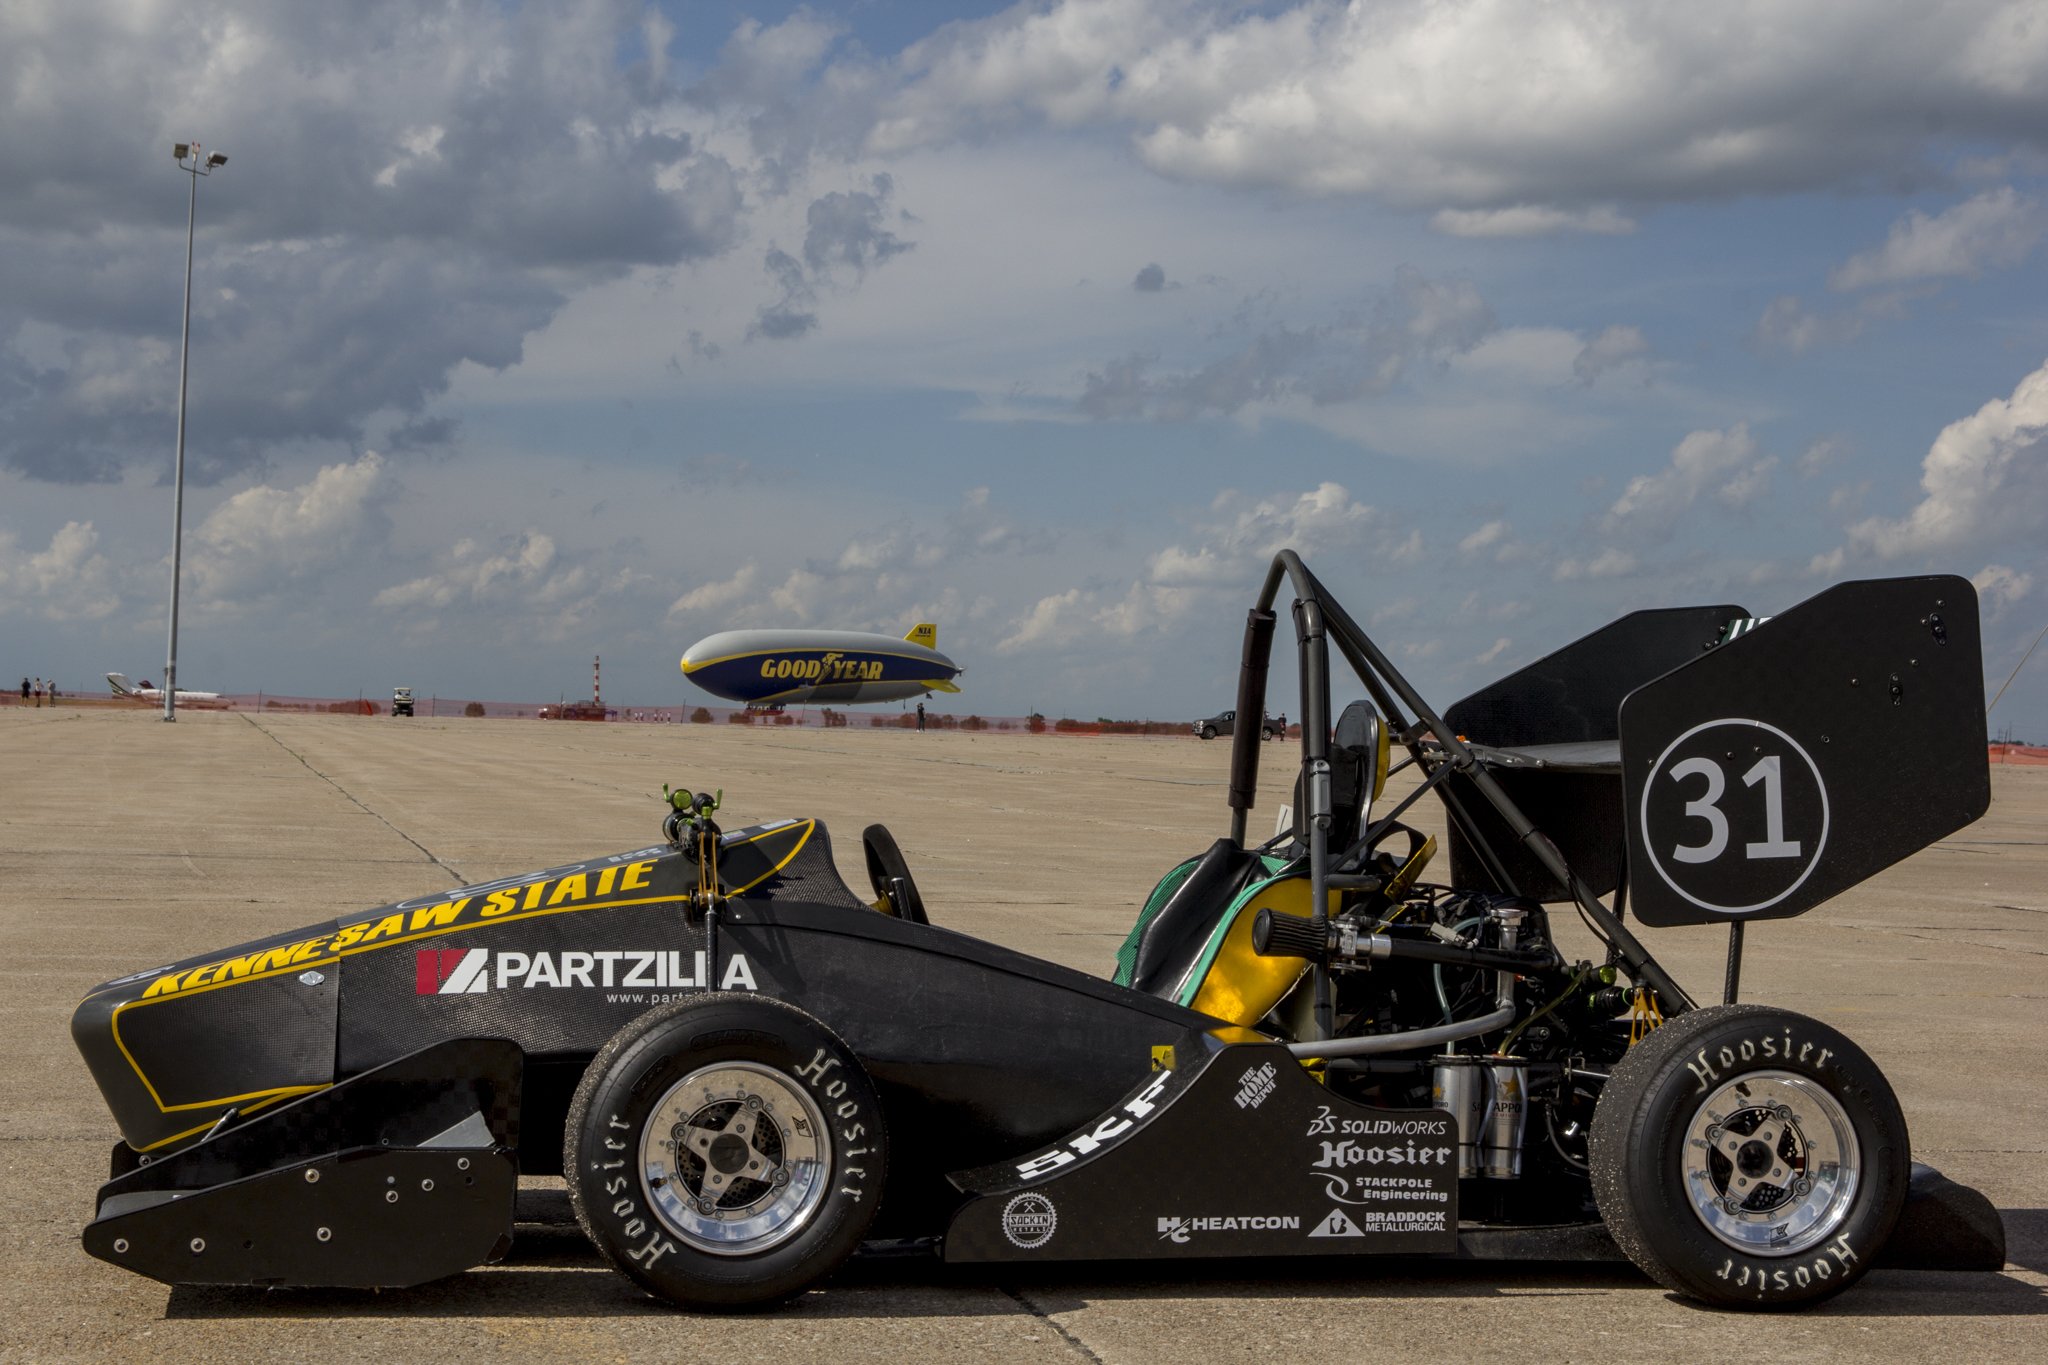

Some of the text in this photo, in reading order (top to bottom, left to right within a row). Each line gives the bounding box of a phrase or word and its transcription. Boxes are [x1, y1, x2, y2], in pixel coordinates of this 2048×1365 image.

[1668, 755, 1800, 864] 31
[142, 859, 658, 1000] KENNESAW STATE
[1238, 1066, 1257, 1086] THE
[1687, 1027, 1834, 1095] Hoosier
[1234, 1062, 1277, 1109] HOME
[1250, 1079, 1277, 1109] DEPOT
[794, 1048, 877, 1202] Hoosier
[1015, 1069, 1172, 1180] SKF
[1340, 1120, 1447, 1135] SOLIDWORKS
[1312, 1139, 1452, 1168] Hoosier
[591, 1114, 677, 1270] Hoosier
[1355, 1177, 1432, 1188] STACKPOLE
[1363, 1189, 1448, 1202] Engineering
[1192, 1216, 1300, 1231] HEATCON
[1366, 1212, 1446, 1222] BRADDOCK
[1366, 1222, 1446, 1232] METALLURGICAL
[1716, 1232, 1858, 1299] Hoosier
